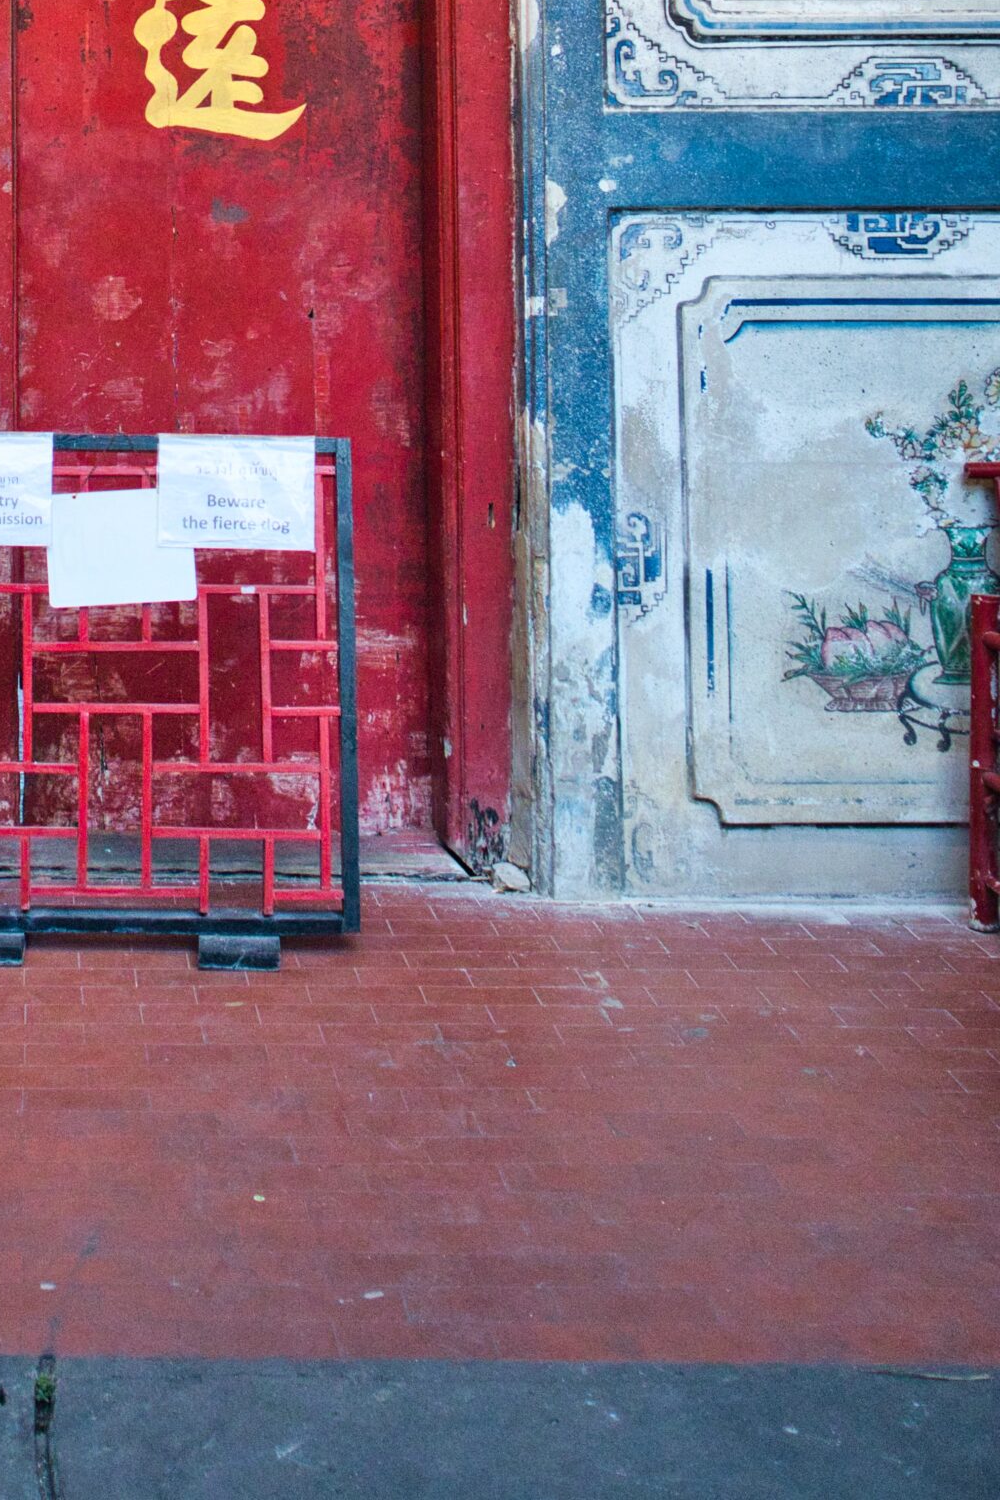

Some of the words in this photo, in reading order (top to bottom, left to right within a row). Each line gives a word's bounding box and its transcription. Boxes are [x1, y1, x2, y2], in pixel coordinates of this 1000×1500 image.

[207, 493, 267, 509] Beware
[182, 515, 208, 530] the
[213, 515, 257, 530] fierce
[261, 518, 291, 535] dog
